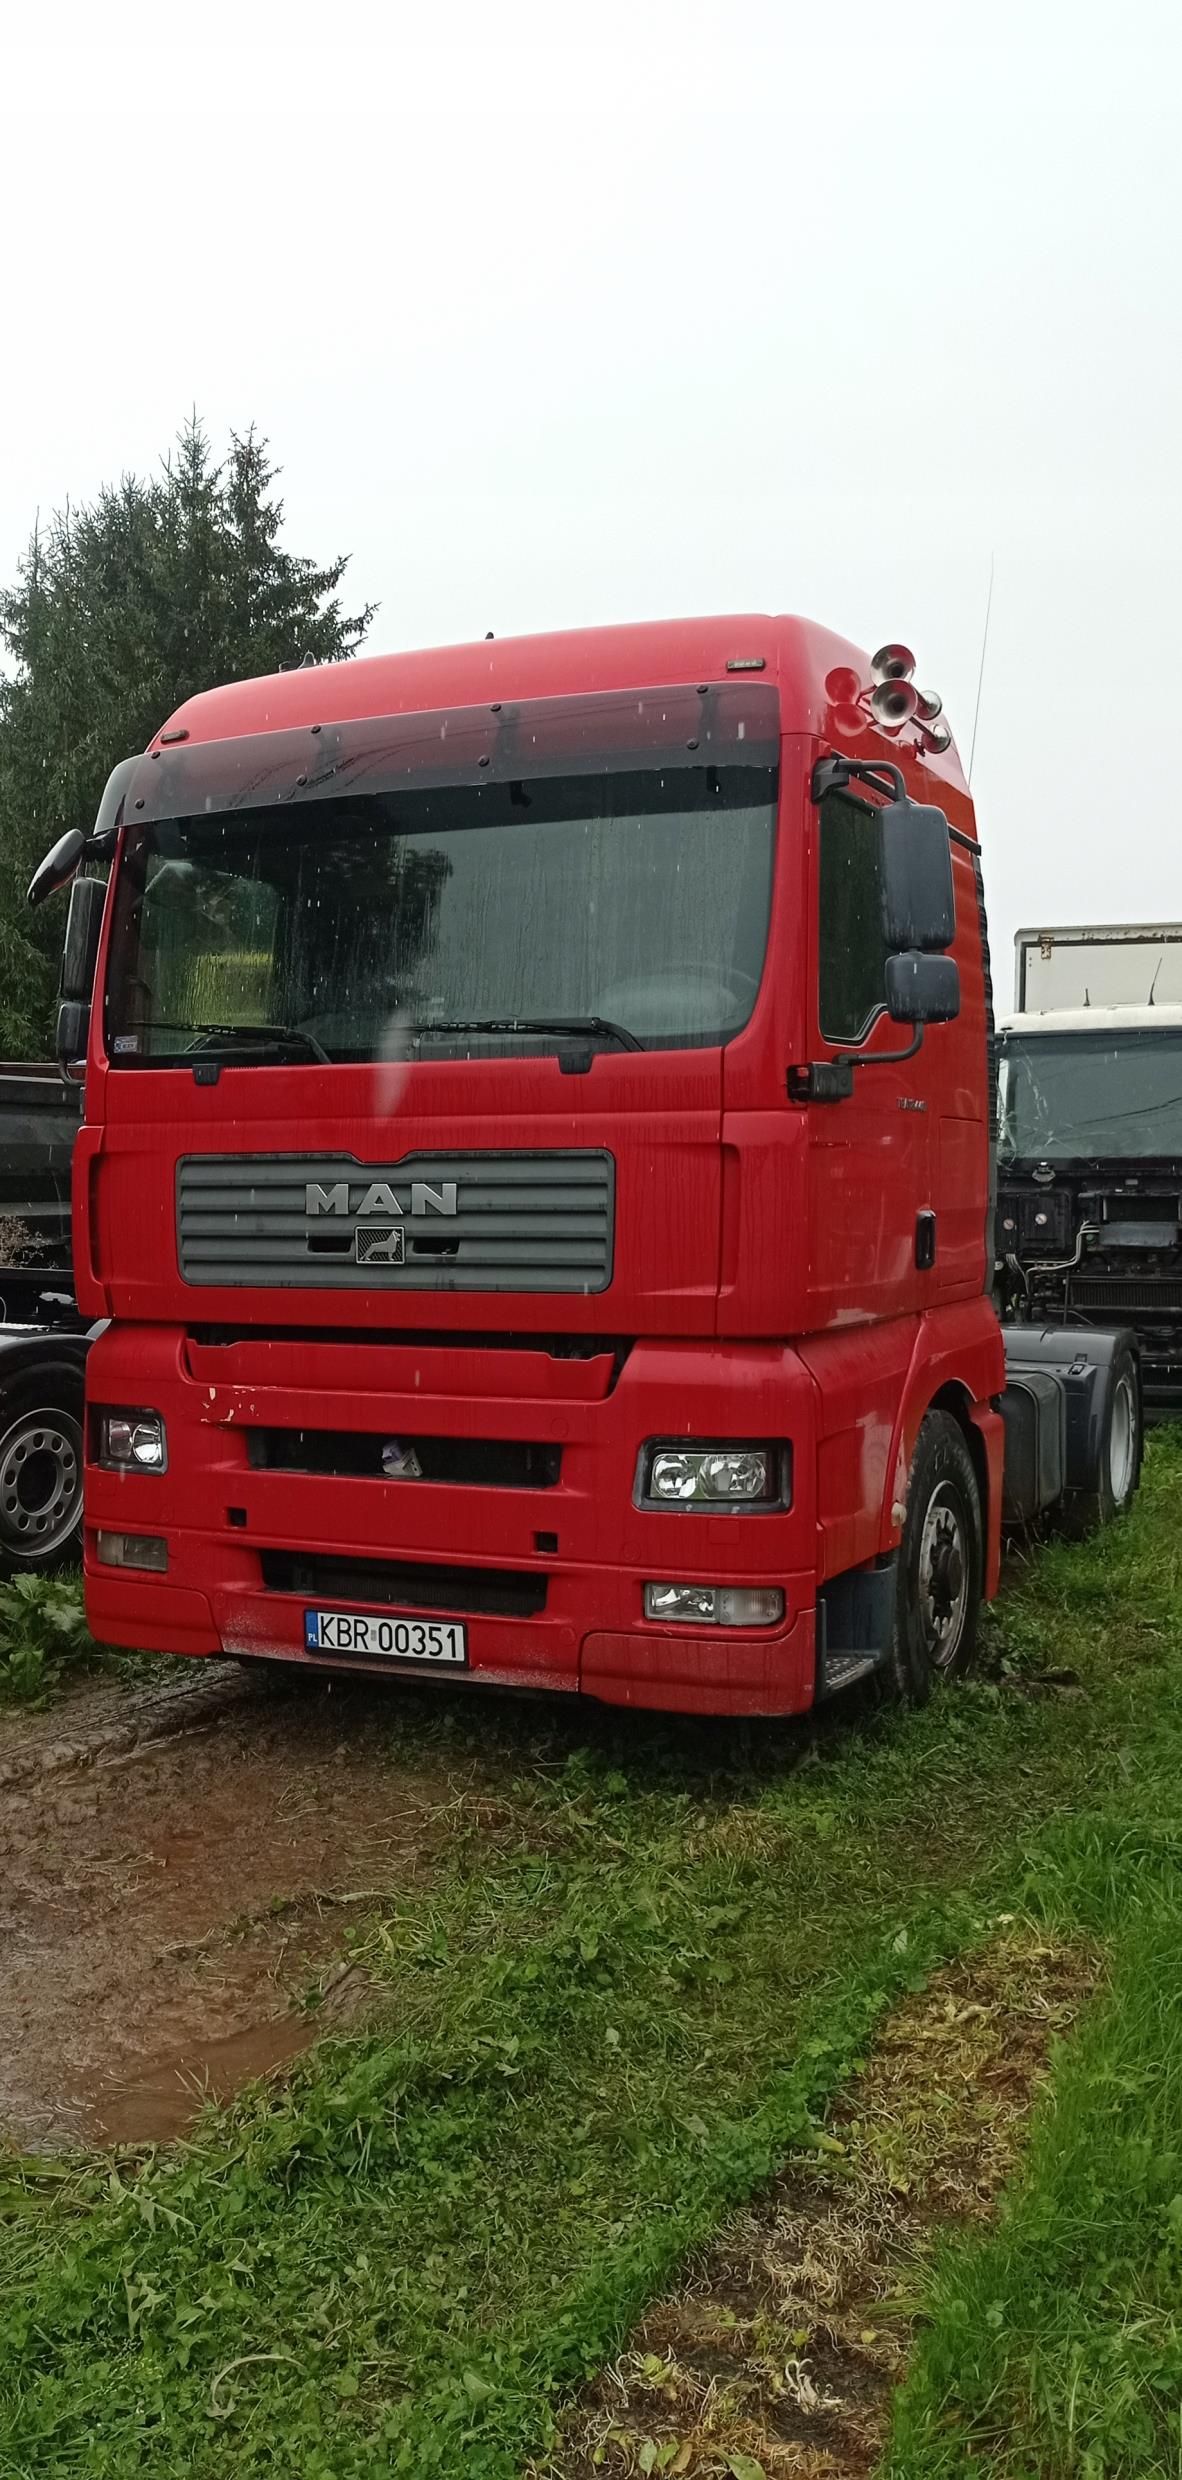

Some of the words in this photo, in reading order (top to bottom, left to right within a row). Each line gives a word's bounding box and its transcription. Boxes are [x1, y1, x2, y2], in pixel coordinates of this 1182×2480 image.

[306, 1183, 457, 1215] MAN
[308, 1633, 318, 1642] PL
[320, 1616, 369, 1650] KBR
[378, 1622, 457, 1658] 00351
